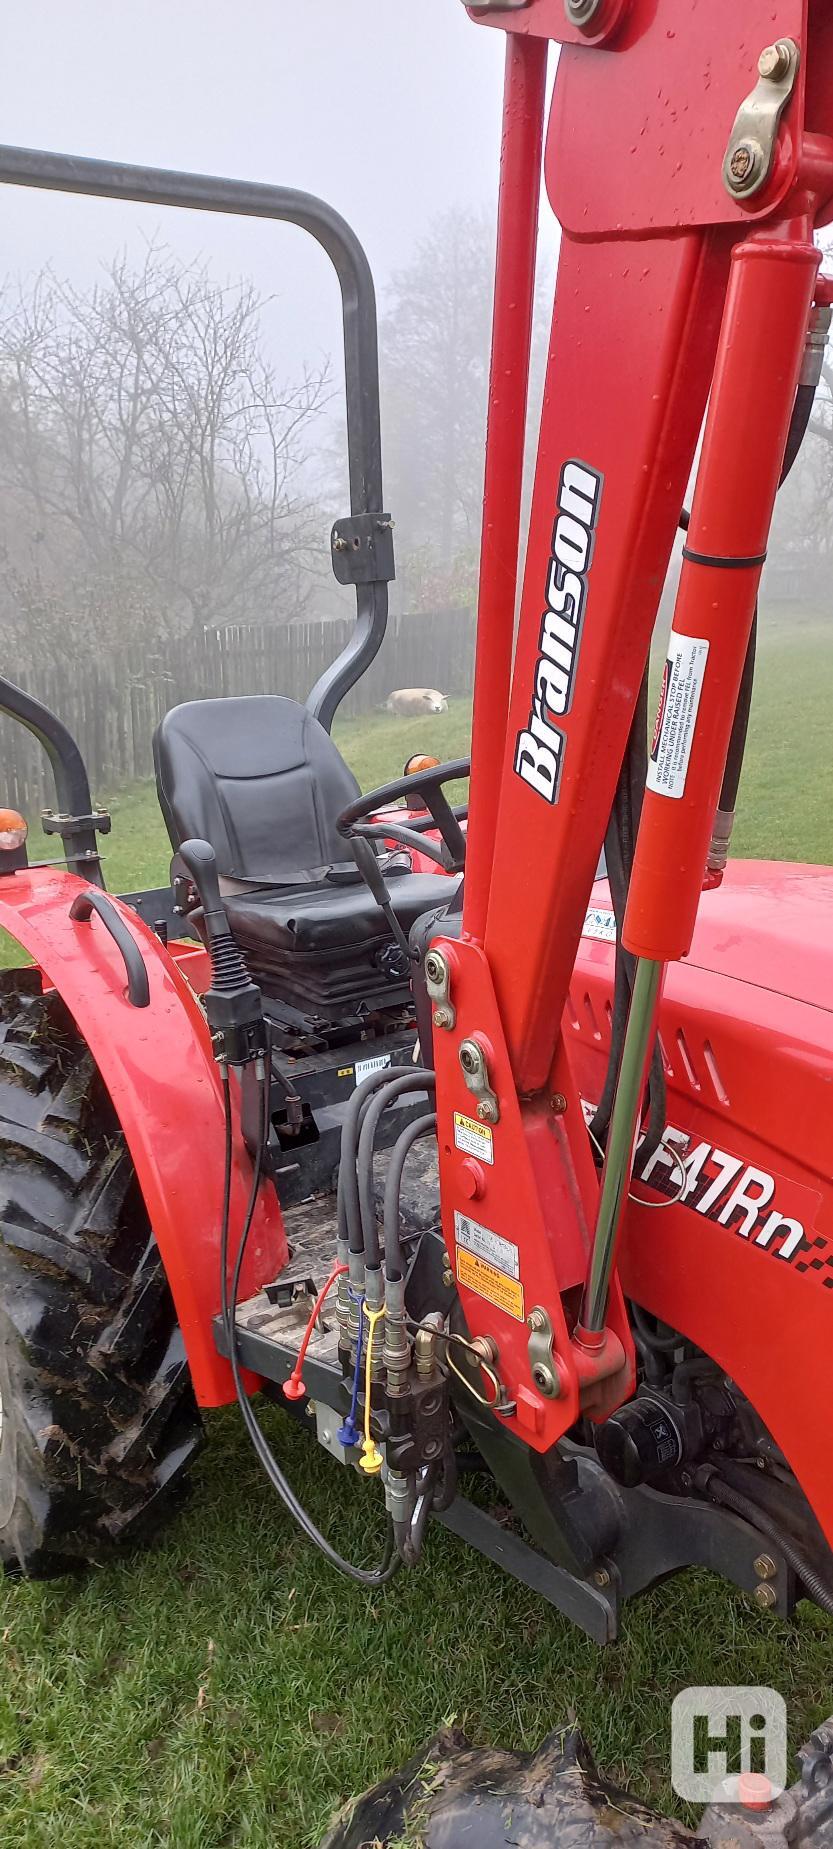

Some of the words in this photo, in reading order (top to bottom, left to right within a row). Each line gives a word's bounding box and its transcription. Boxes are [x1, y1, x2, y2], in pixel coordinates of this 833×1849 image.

[514, 460, 602, 804] Branson
[656, 755, 665, 783] INSTALL
[661, 705, 673, 753] MECHANICAL
[673, 652, 682, 681] BEFORE
[662, 748, 673, 784] WORKING
[668, 721, 677, 747] UNDER
[673, 692, 682, 719] RAISED
[674, 721, 684, 760] recommended
[689, 646, 697, 664] Tractor
[681, 724, 690, 753] performing
[688, 679, 697, 712] maintenance
[641, 1125, 805, 1260] F47Rn
